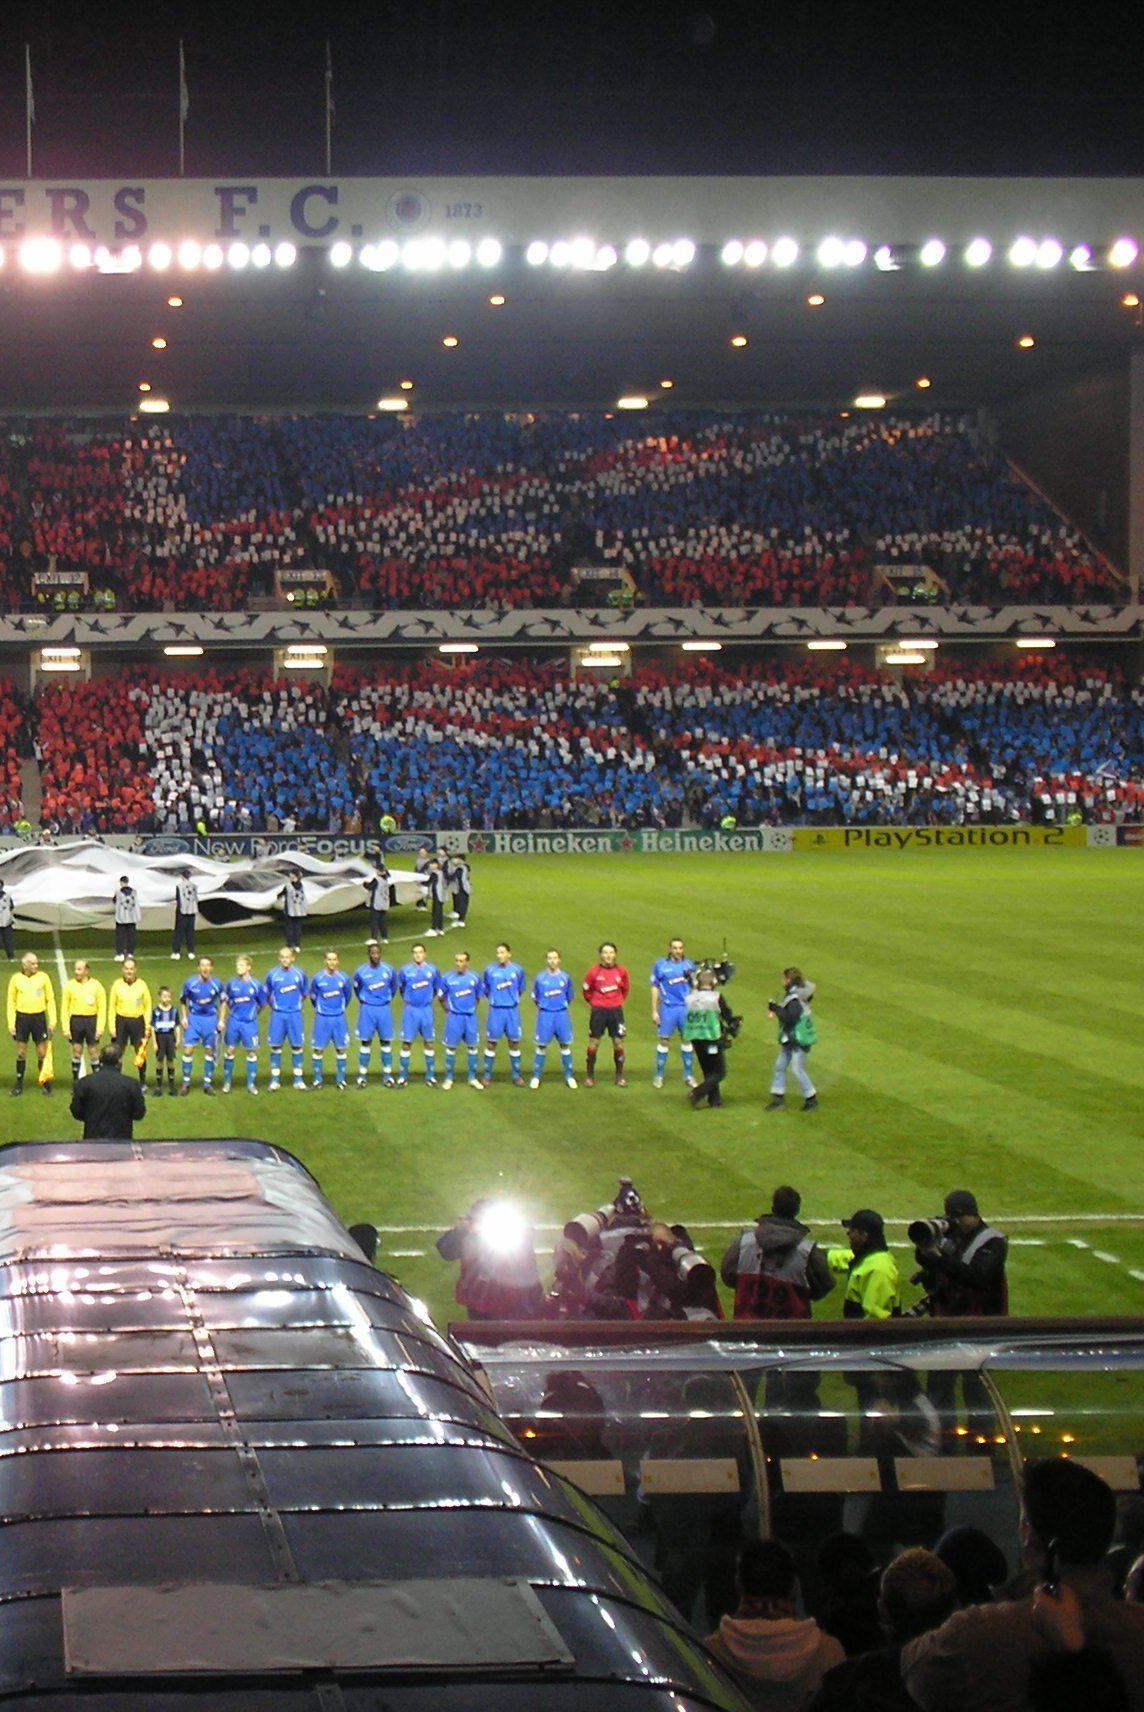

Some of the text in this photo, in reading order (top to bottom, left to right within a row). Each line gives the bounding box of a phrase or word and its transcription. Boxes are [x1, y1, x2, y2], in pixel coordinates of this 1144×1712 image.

[214, 184, 363, 239] F.C.
[194, 838, 245, 855] New
[494, 833, 613, 855] Heineken
[641, 831, 760, 852] Heineken
[844, 826, 1065, 850] PlayStation 2
